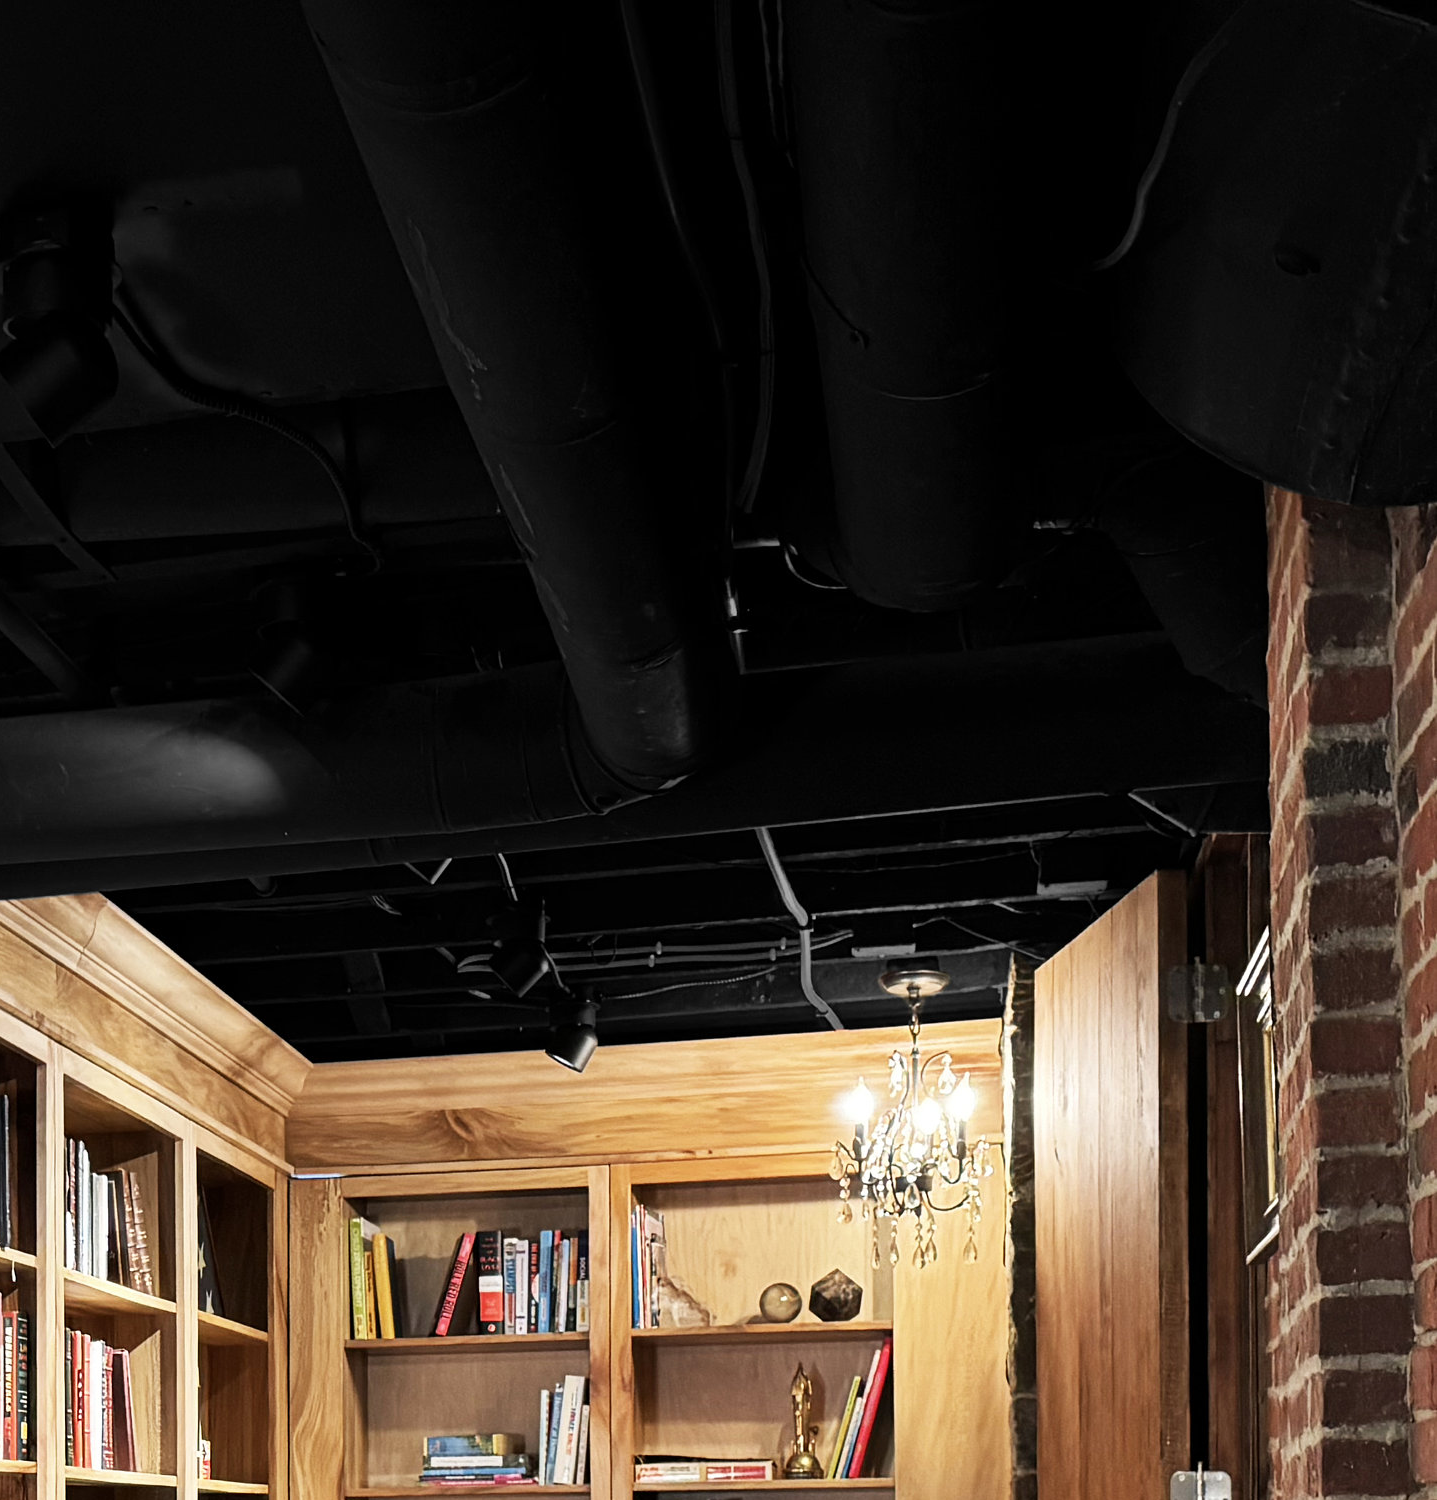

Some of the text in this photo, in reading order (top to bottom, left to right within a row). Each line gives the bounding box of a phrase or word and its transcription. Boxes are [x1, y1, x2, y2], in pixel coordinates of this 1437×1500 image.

[440, 1260, 466, 1319] ROLL RED ROLL
